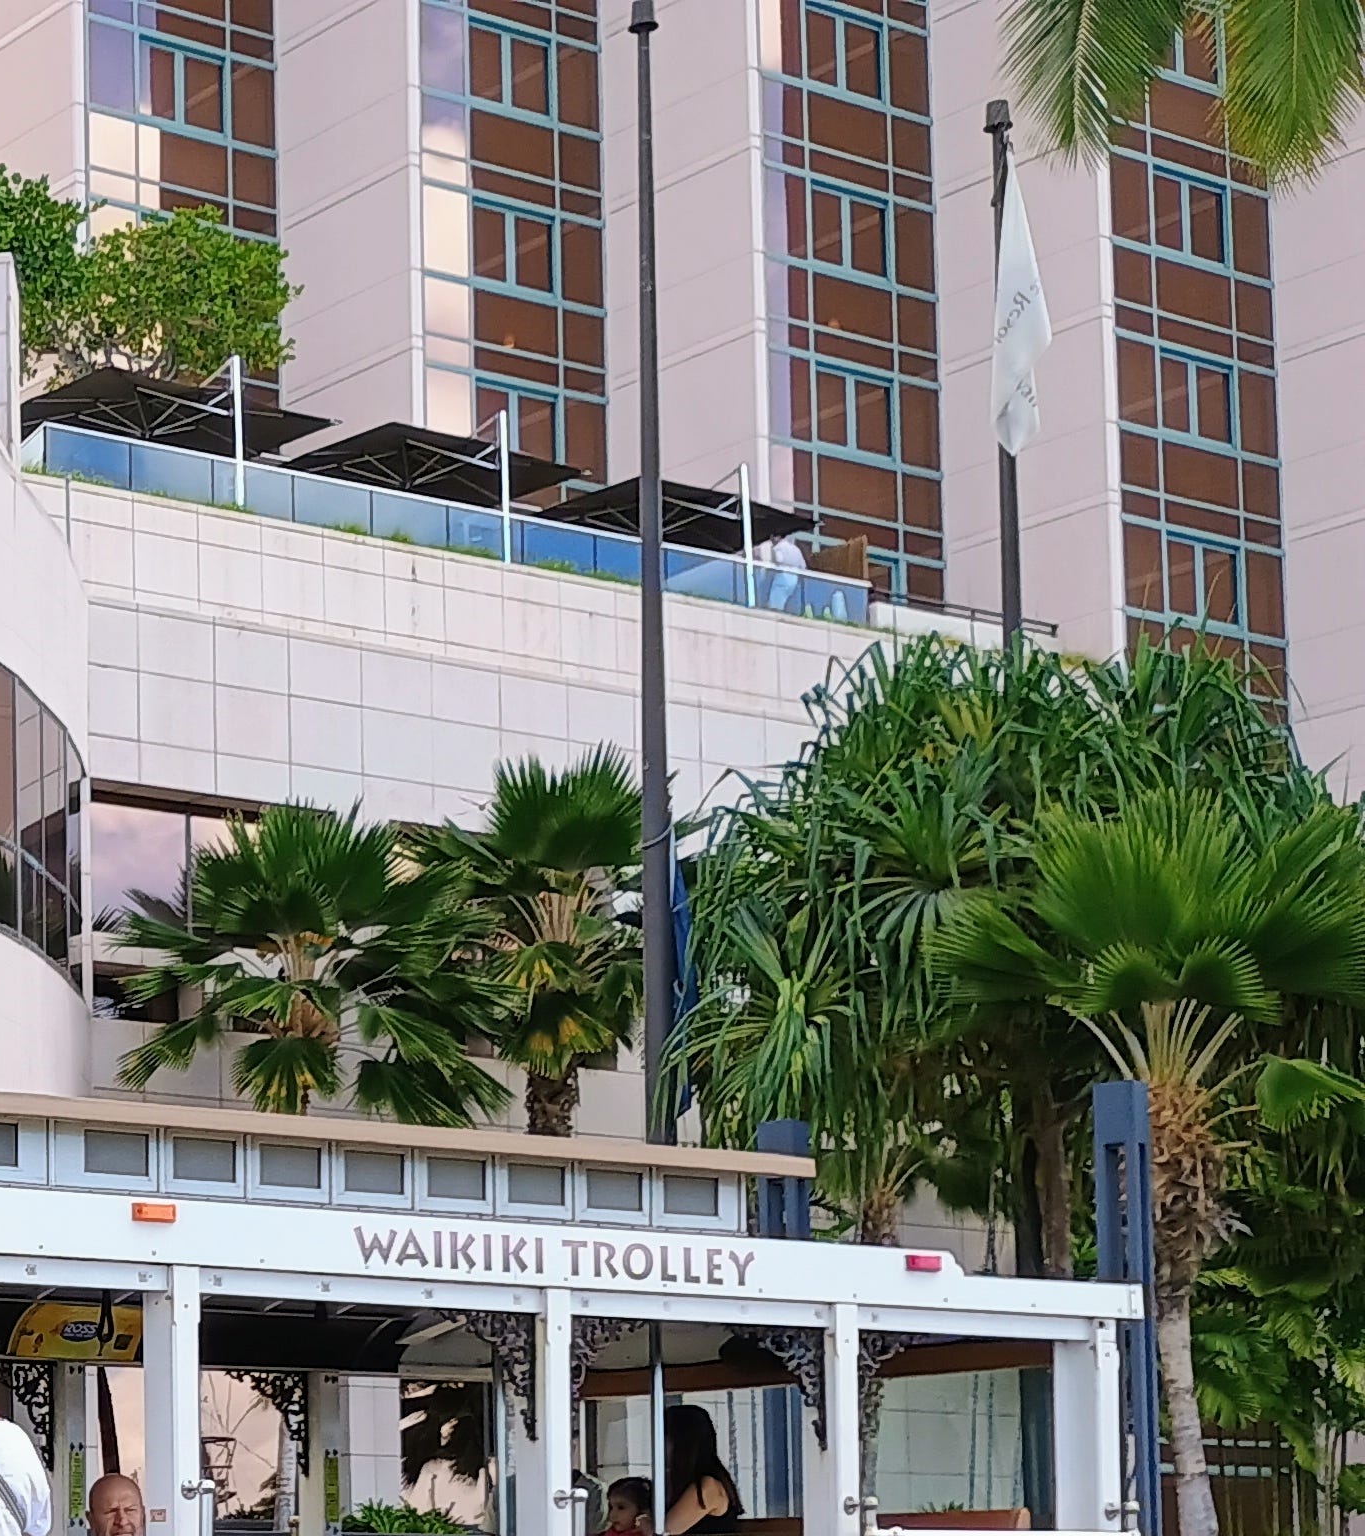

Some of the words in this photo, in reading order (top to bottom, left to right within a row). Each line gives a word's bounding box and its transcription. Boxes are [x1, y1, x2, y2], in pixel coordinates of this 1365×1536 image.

[353, 1225, 545, 1276] WAIKIKI
[561, 1238, 756, 1288] TROLLEY
[62, 1323, 98, 1334] ROSS
